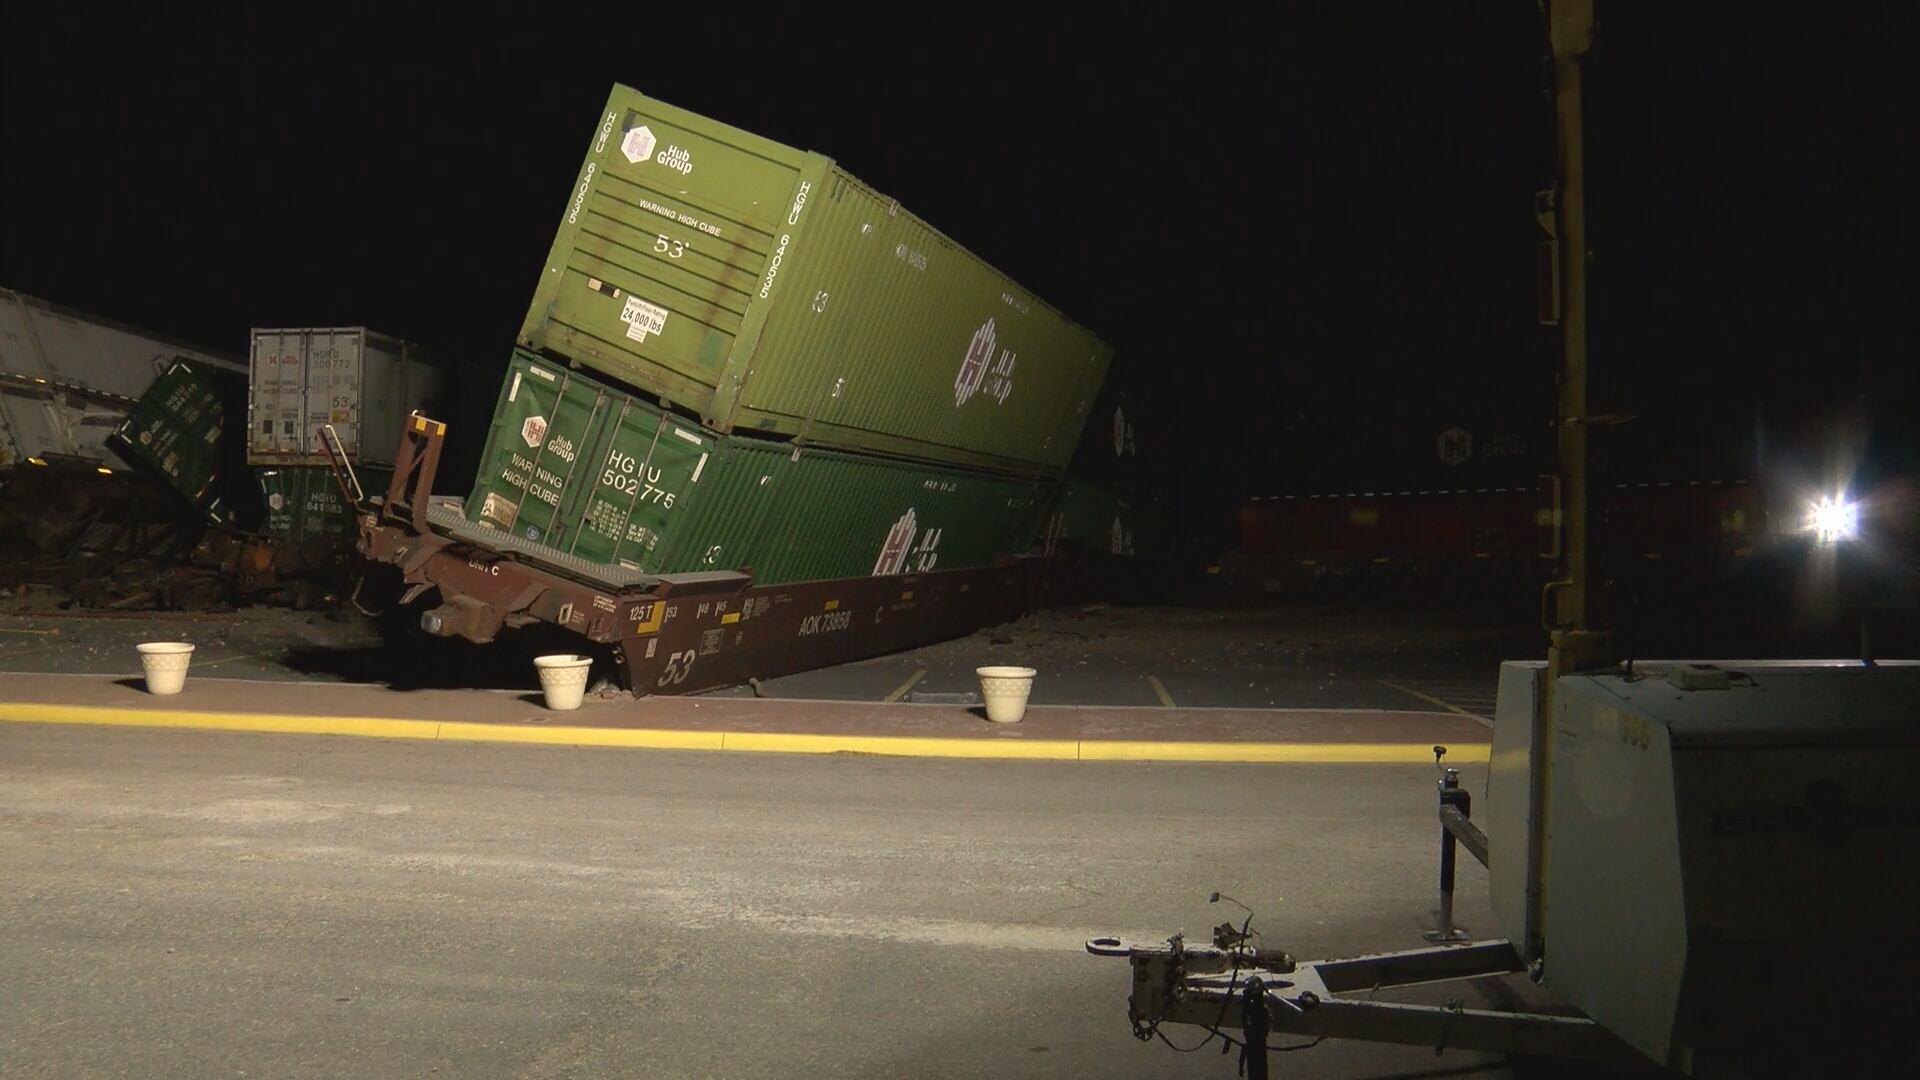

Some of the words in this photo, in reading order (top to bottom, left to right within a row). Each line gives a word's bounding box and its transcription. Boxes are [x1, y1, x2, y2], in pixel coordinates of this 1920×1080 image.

[595, 111, 617, 153] HGWU
[657, 151, 693, 174] Group
[667, 144, 690, 162] Hub
[568, 162, 596, 224] 640535
[787, 181, 811, 225] HGWU
[639, 199, 676, 219] WARNING
[678, 213, 698, 228] HIGH
[699, 221, 722, 237] CUBE
[760, 234, 790, 298] 640535
[649, 318, 662, 333] lbs
[547, 440, 575, 463] Group
[556, 434, 573, 451] Hub
[501, 468, 529, 490] HIGH
[529, 483, 560, 506] CUBE
[491, 565, 500, 576] C
[629, 606, 645, 622] 125
[645, 604, 654, 620] T
[798, 615, 820, 637] AOK
[657, 649, 696, 688] 53
